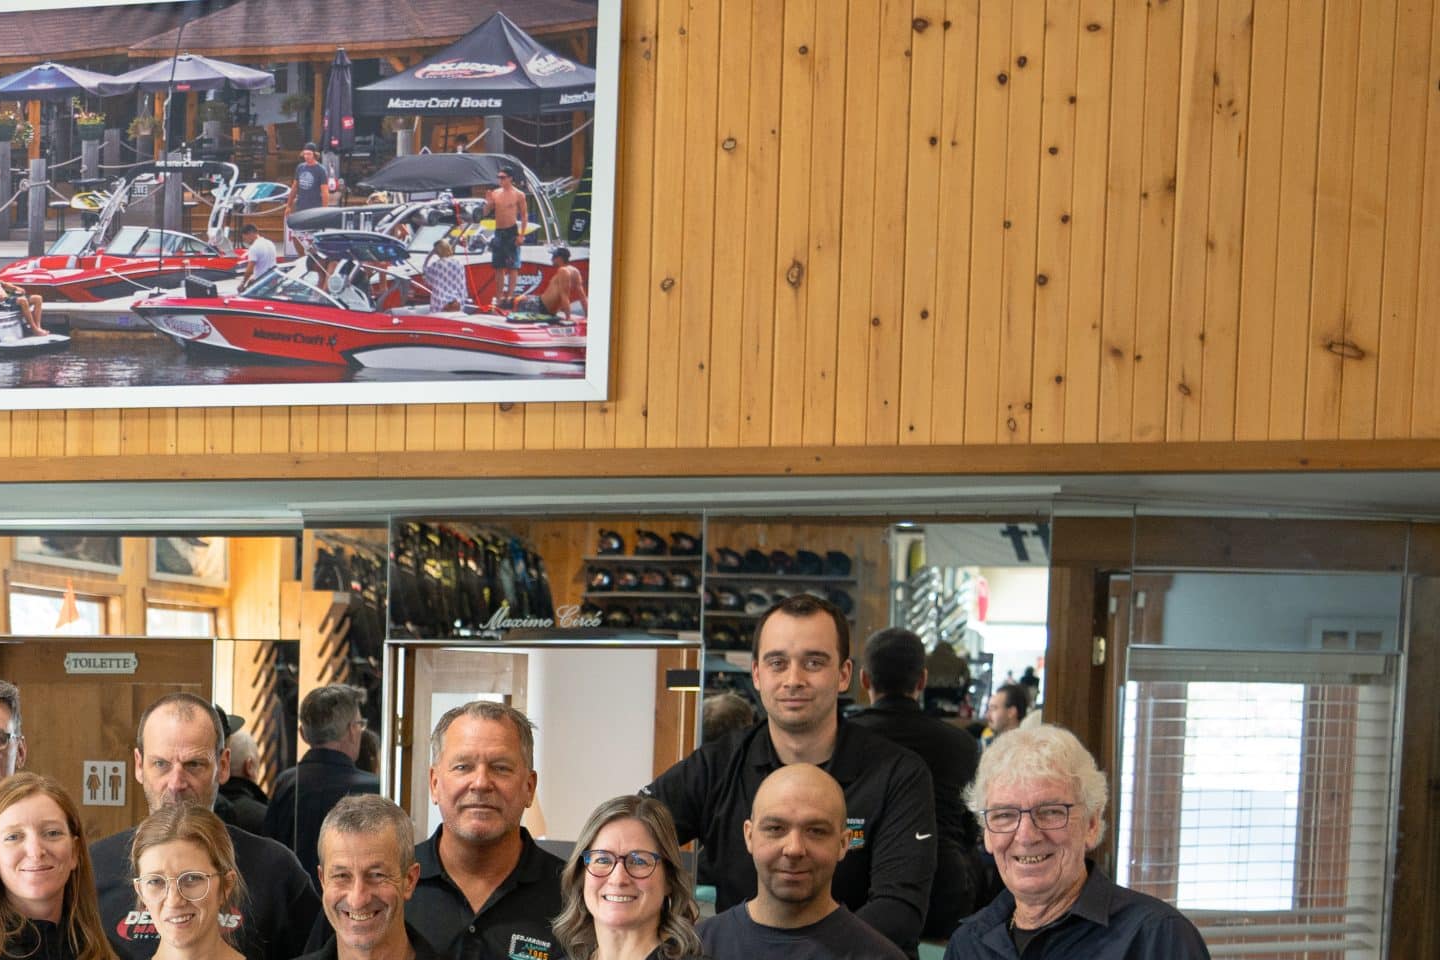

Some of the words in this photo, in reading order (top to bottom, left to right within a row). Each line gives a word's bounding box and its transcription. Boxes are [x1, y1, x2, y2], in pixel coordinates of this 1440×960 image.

[387, 97, 459, 109] MasterCraft
[460, 97, 503, 108] Boats
[479, 606, 554, 630] Maxime
[557, 605, 603, 628] Circé
[71, 657, 131, 669] TOILETTE
